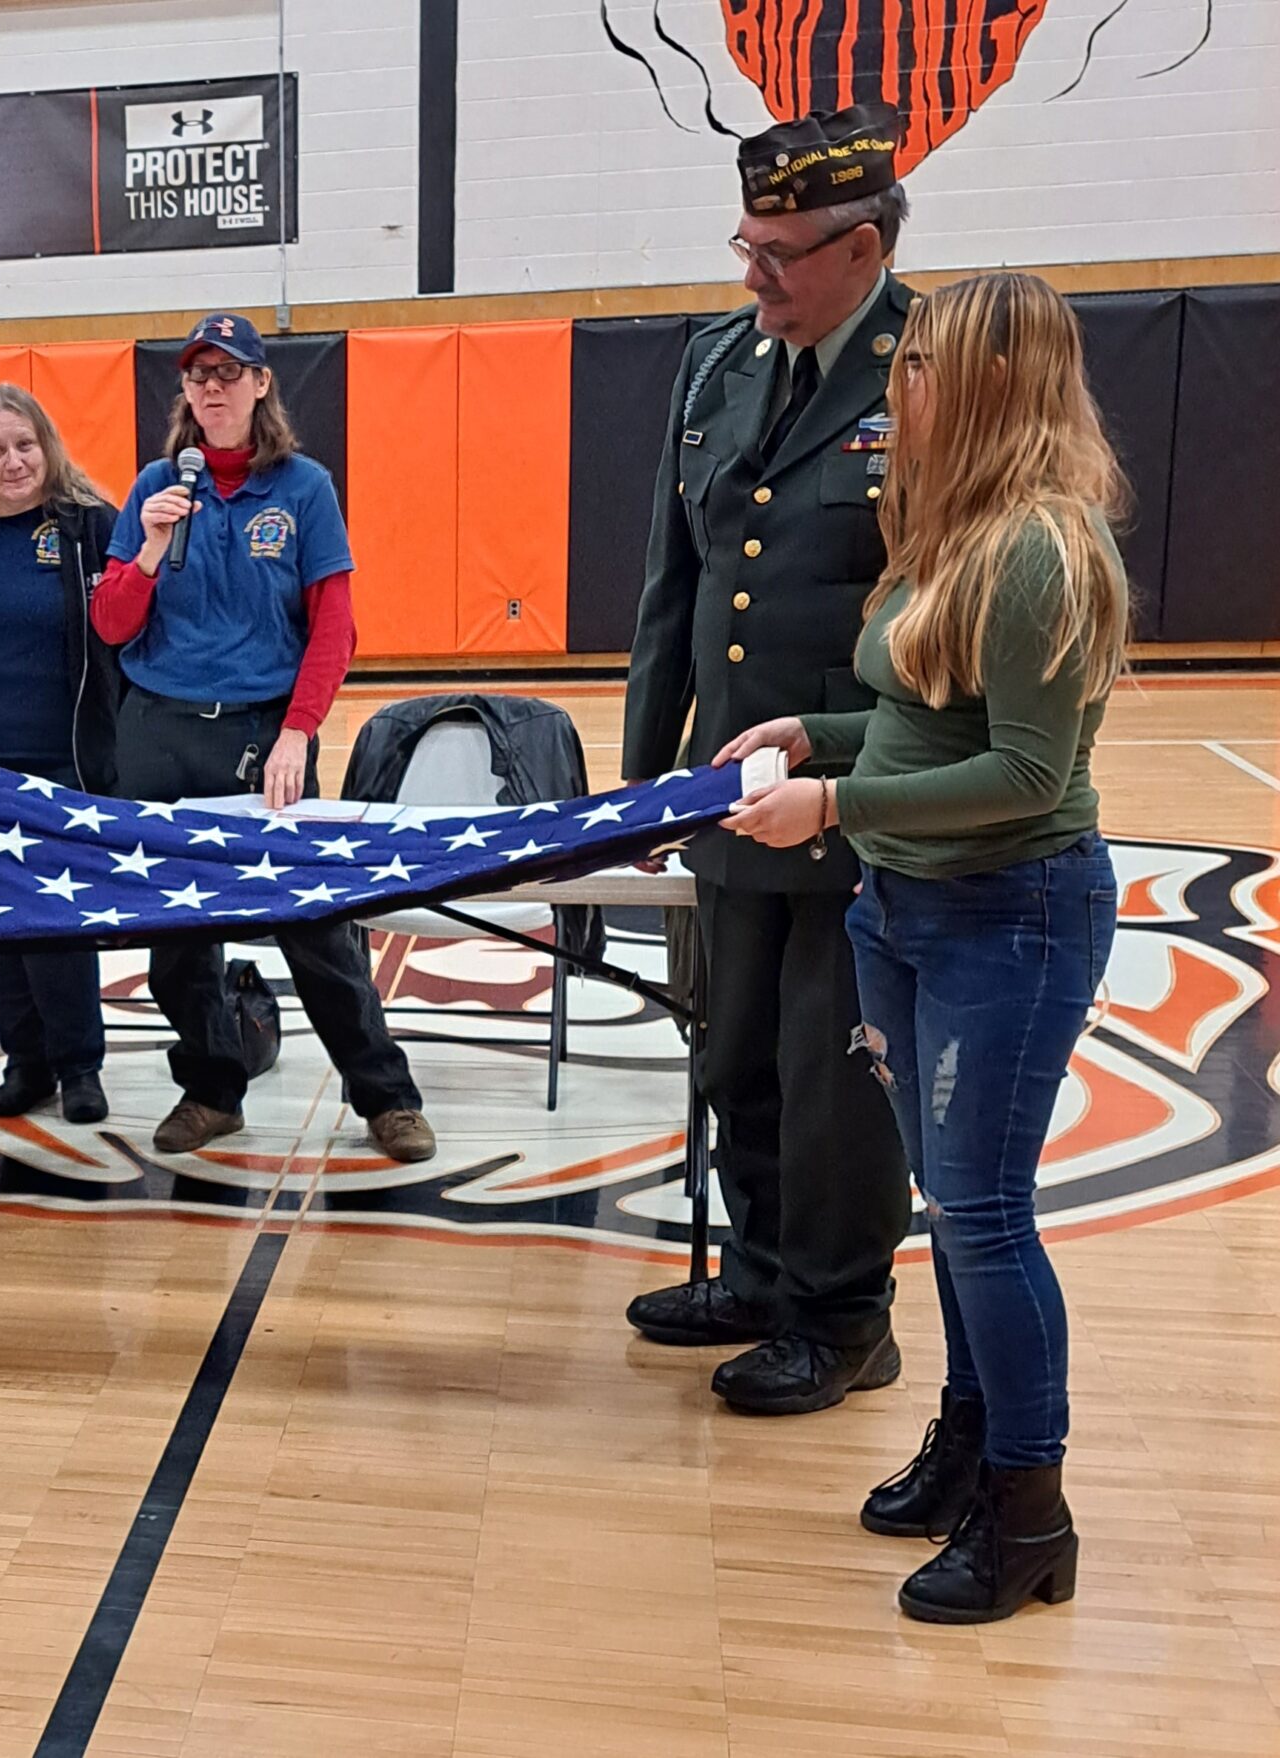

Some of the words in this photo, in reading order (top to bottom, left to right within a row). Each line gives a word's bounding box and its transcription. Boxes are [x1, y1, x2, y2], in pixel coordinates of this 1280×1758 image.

[125, 143, 263, 188] PROTECT
[769, 150, 827, 185] NATIONAL
[125, 190, 178, 220] THIS
[184, 184, 270, 217] HOUSE.
